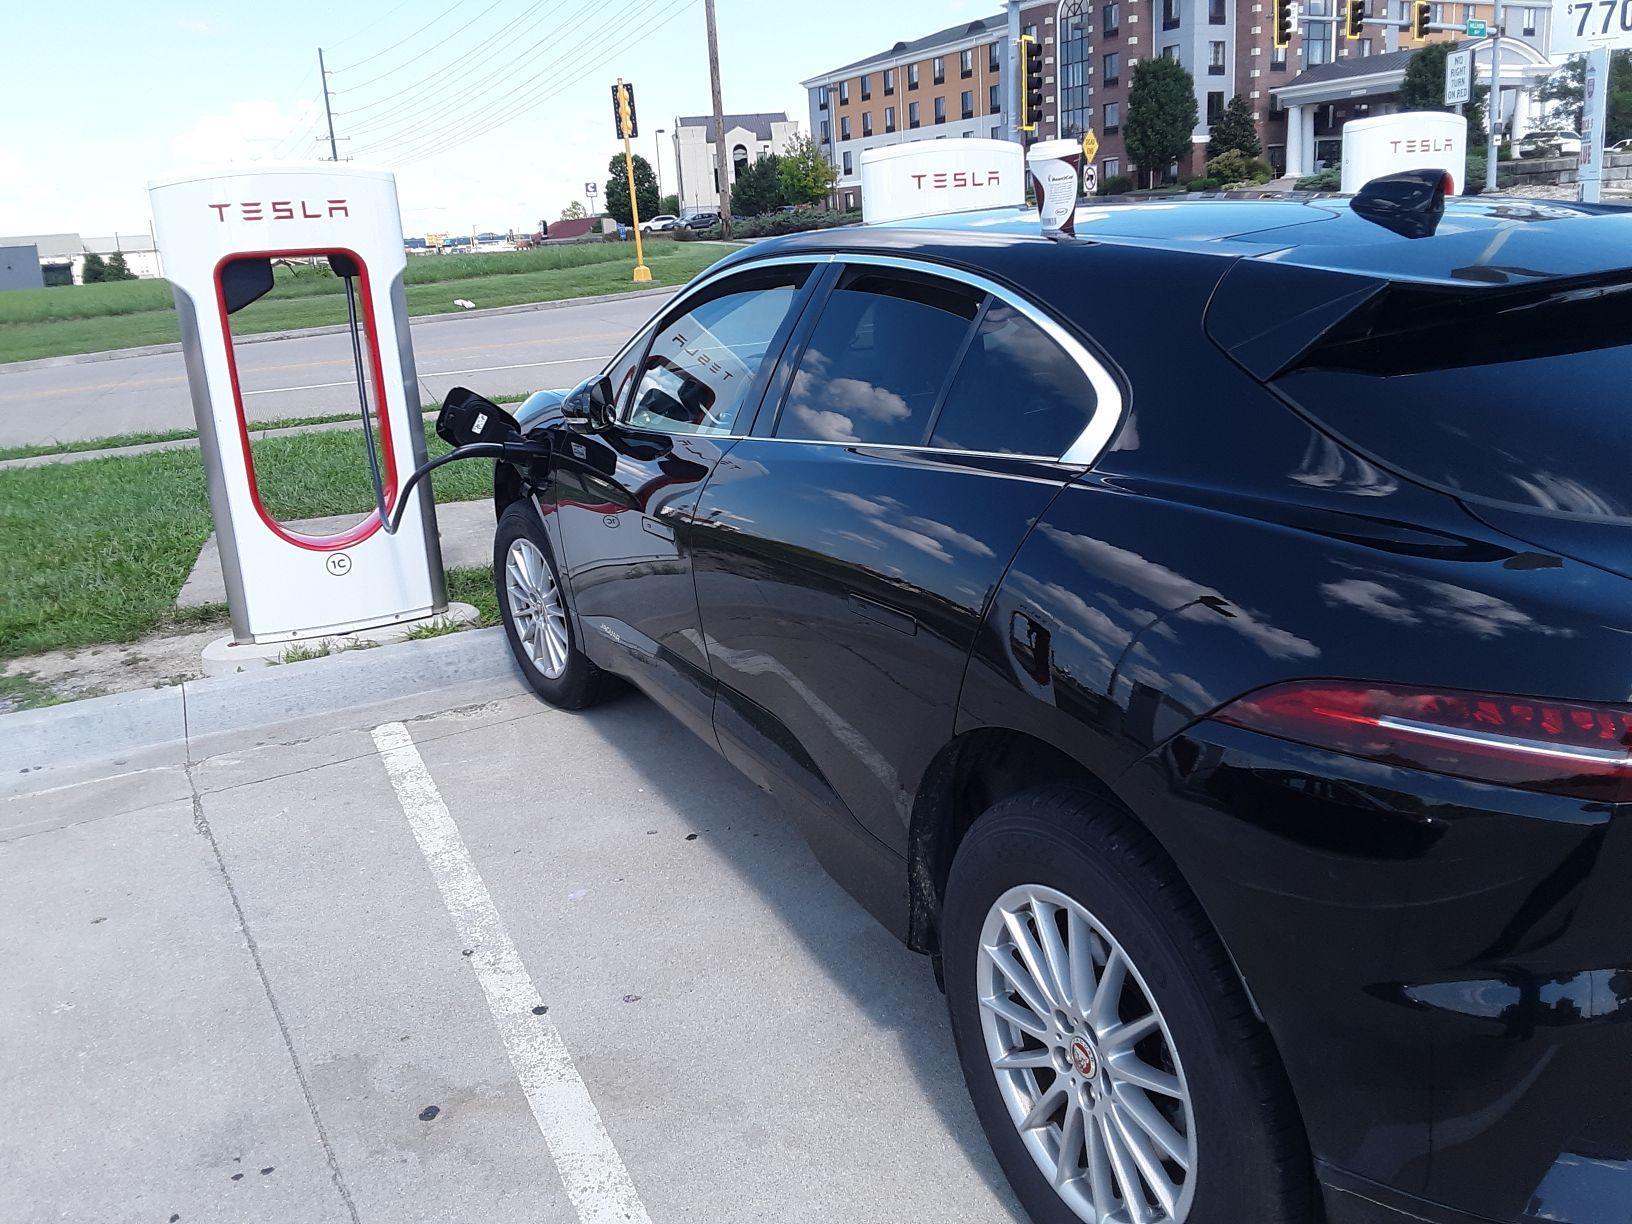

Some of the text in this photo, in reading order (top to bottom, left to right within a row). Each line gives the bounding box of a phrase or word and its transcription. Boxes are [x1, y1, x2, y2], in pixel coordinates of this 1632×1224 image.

[1454, 56, 1464, 65] NO
[1450, 66, 1466, 77] RIGHT
[1451, 78, 1465, 87] TURN
[1448, 88, 1467, 99] ON RED
[1389, 139, 1453, 154] TESLA
[911, 171, 1000, 190] TESLA
[208, 200, 349, 222] TESLA
[331, 559, 346, 569] 1C
